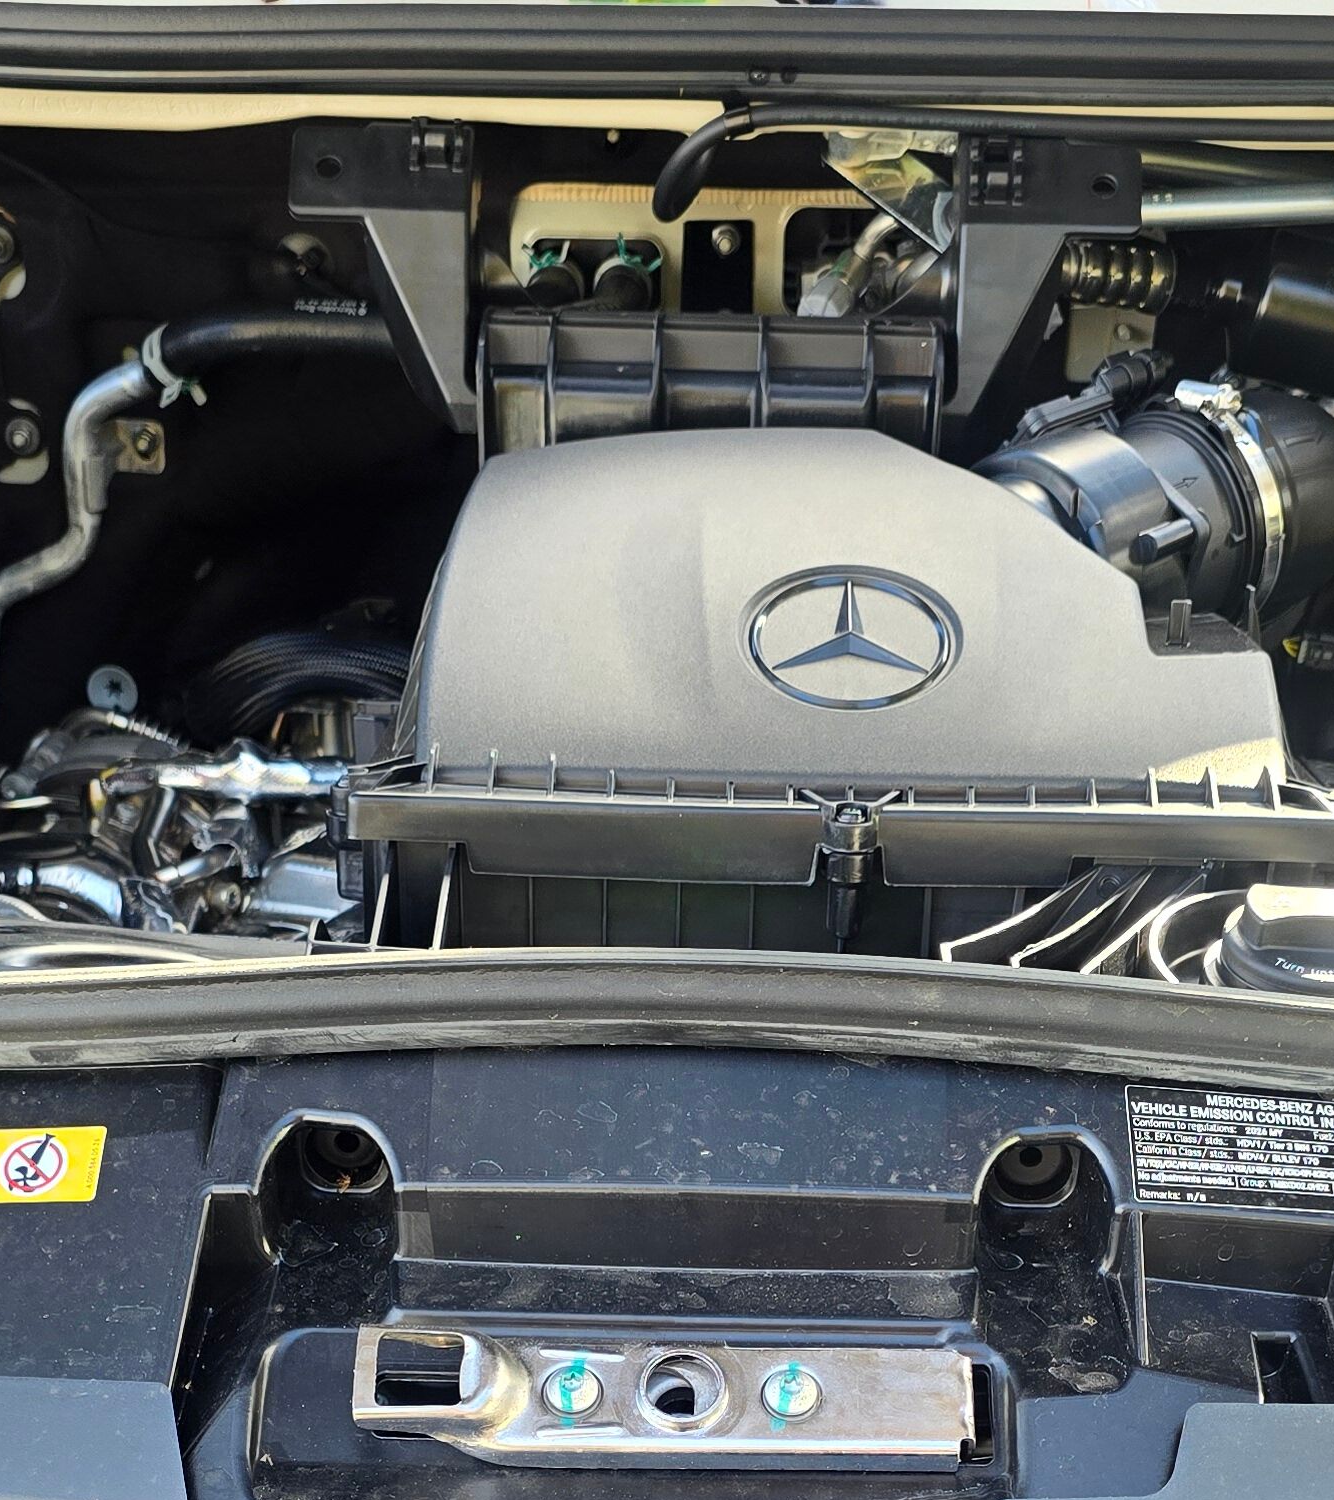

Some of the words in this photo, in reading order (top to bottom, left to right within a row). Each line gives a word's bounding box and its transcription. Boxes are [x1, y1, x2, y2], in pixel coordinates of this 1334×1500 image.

[1274, 957, 1305, 974] Turn
[1206, 1094, 1314, 1115] MERCEDES-BENZ
[1316, 1104, 1334, 1116] AG
[1131, 1102, 1187, 1116] VEHICLE
[1190, 1106, 1253, 1122] EMISSION
[1255, 1111, 1319, 1128] CONTROL
[1133, 1118, 1175, 1128] Conforms
[1177, 1121, 1186, 1129] to
[1188, 1122, 1237, 1133] regulations:
[1134, 1131, 1153, 1141] U.S.
[1155, 1132, 1172, 1141] EPA
[1136, 1144, 1177, 1156] California
[1138, 1171, 1150, 1180] No
[1151, 1172, 1201, 1183] adjustments
[1240, 1178, 1267, 1188] Group:
[1139, 1189, 1181, 1200] Remarks:
[1187, 1192, 1206, 1202] n/a
